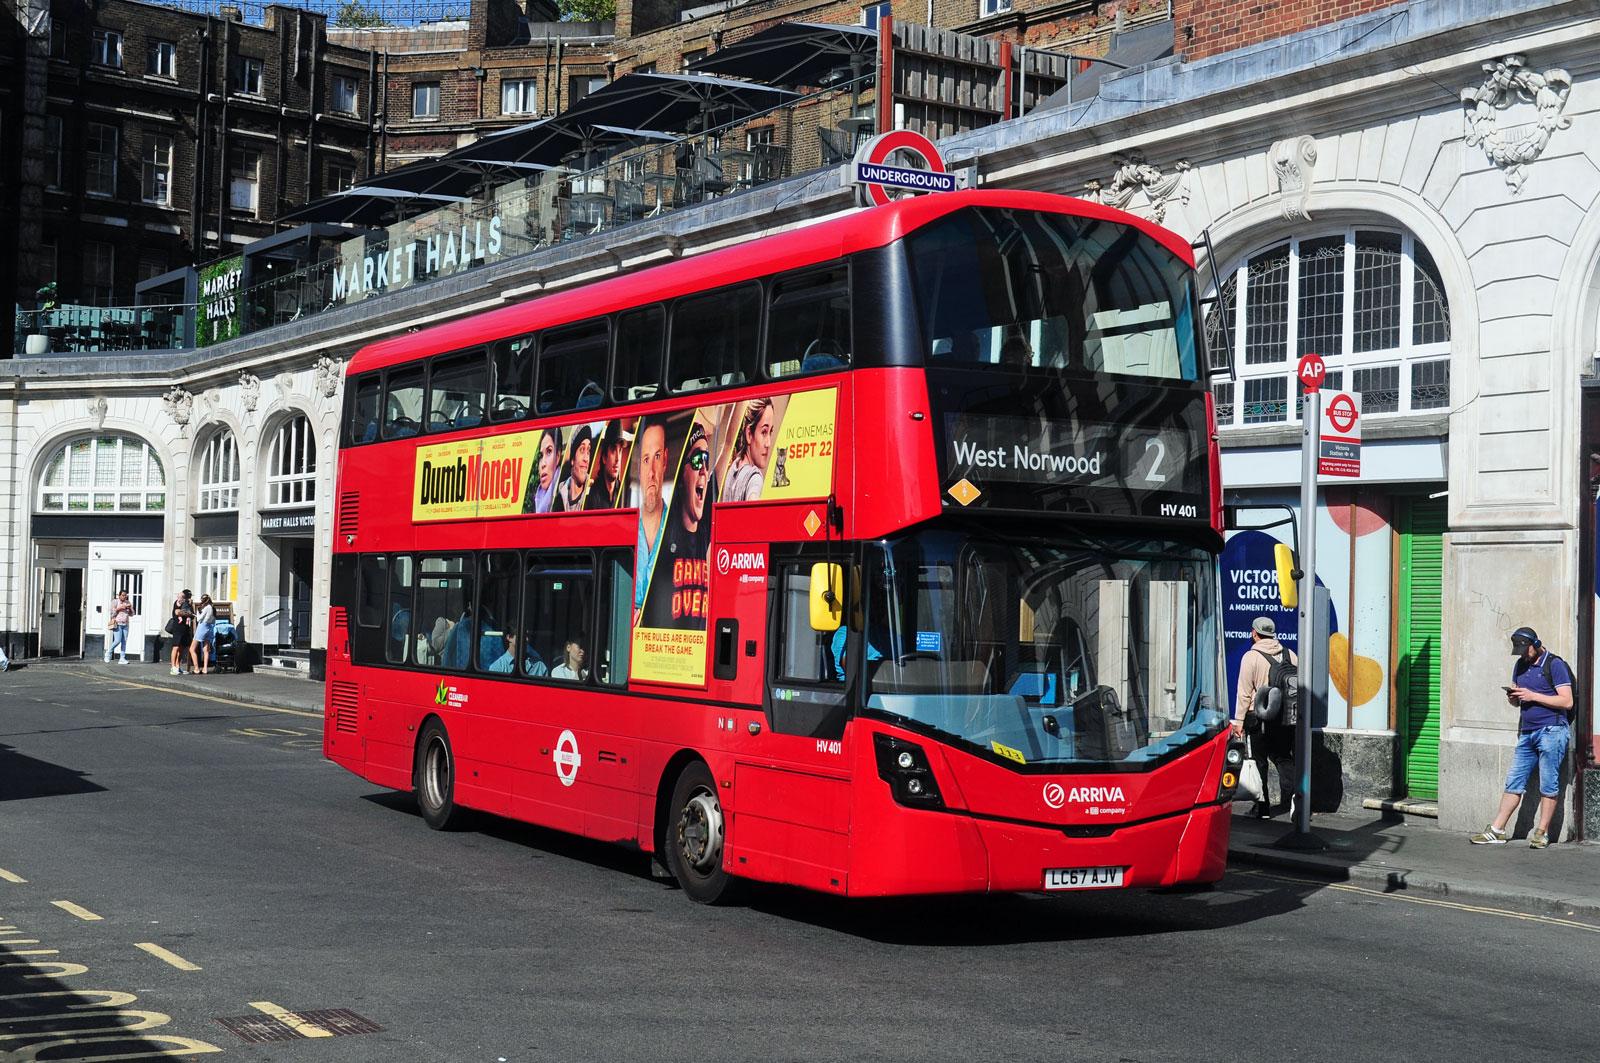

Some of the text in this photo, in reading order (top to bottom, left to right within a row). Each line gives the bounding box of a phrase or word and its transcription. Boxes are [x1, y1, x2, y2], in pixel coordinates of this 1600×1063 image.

[862, 167, 951, 189] UNDERGROUND
[332, 215, 501, 301] MARKET HALLS
[203, 269, 241, 297] MARKET
[207, 296, 235, 319] HALLS
[1302, 362, 1323, 377] AP
[786, 423, 833, 439] IN CINEMAS
[789, 441, 832, 459] SEPT 22
[953, 440, 1100, 475] West Norwood
[1144, 437, 1166, 482] 2
[1160, 503, 1196, 518] HV 401
[262, 516, 316, 528] MARKET HALLS VICTOR
[730, 552, 766, 569] ARRIVA
[1230, 569, 1279, 584] VICTOR
[1235, 604, 1264, 612] MOMENT
[635, 632, 705, 646] IF THE RULES ARE RIGGED,
[645, 644, 693, 656] BREAK THE GAME.
[816, 740, 842, 755] HV 401
[1068, 786, 1126, 803] ARRIVA
[1052, 868, 1117, 886] LC67 AJV
